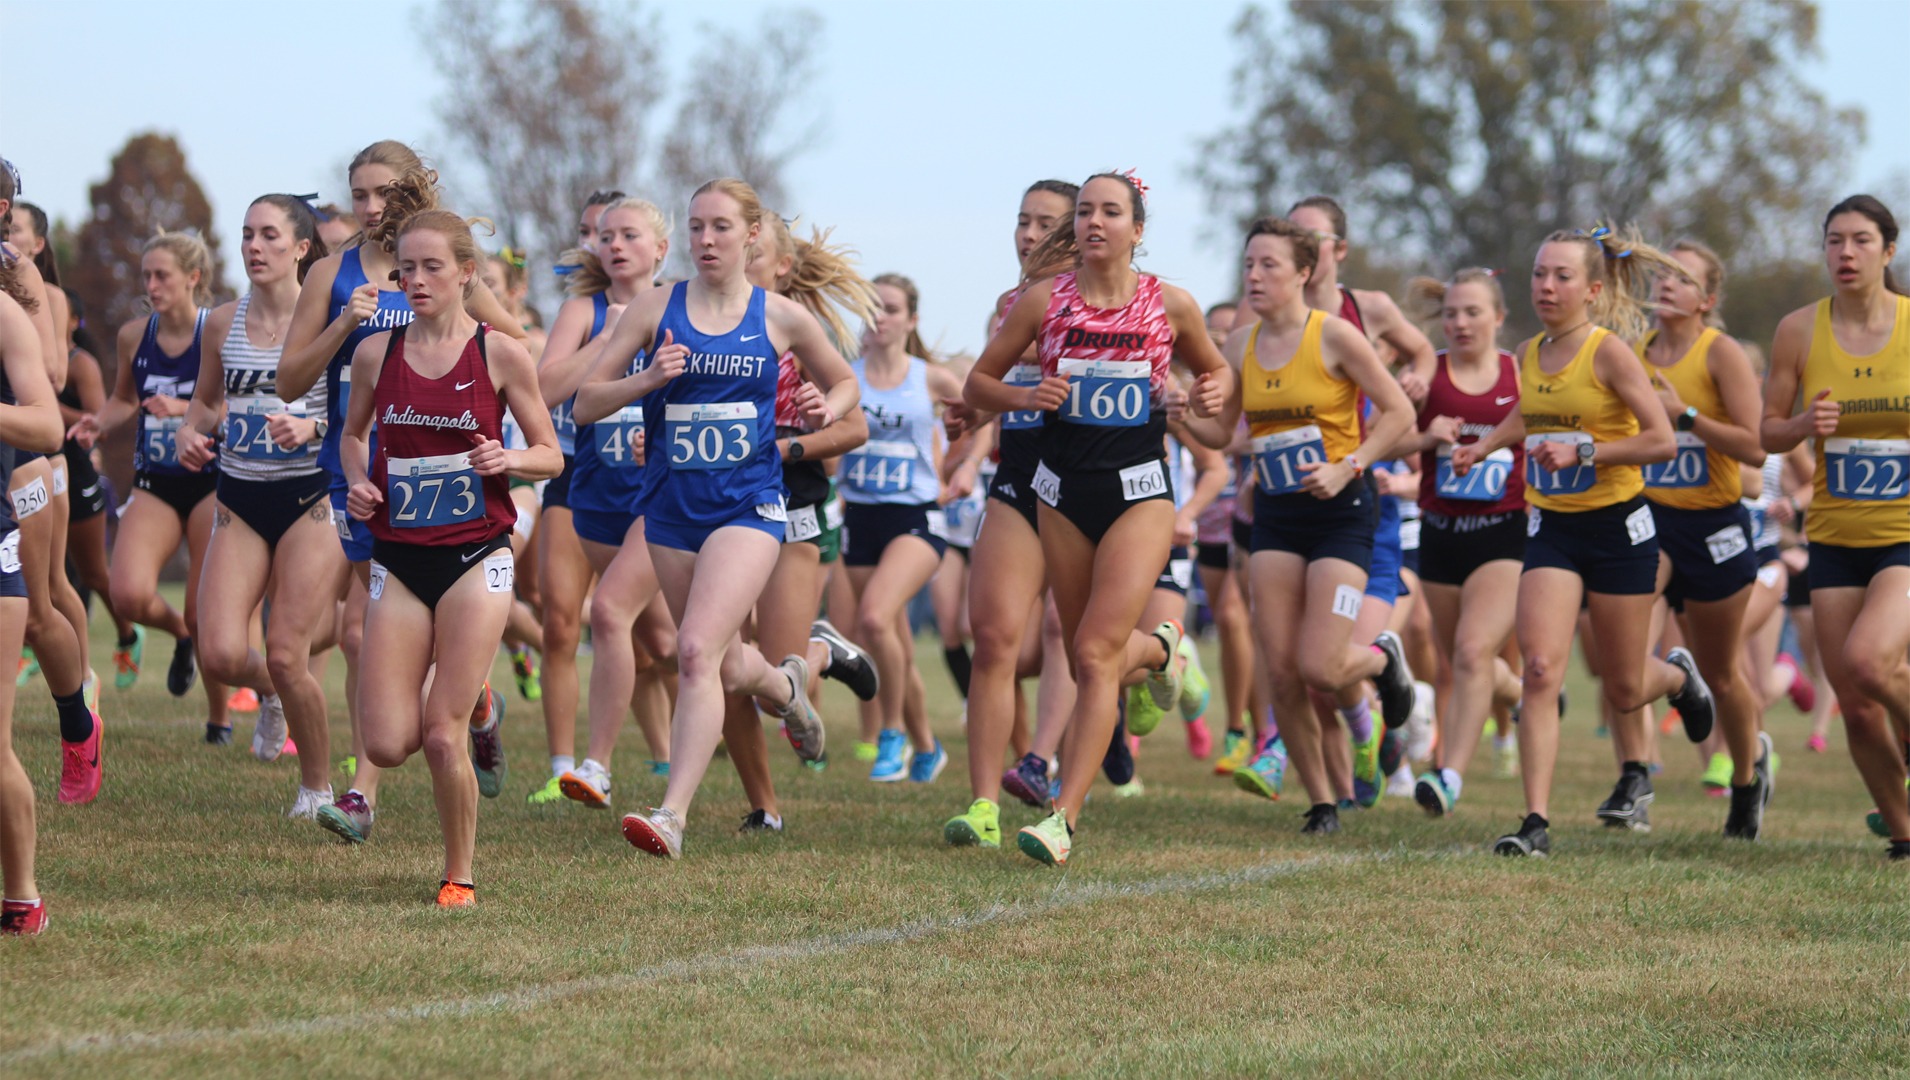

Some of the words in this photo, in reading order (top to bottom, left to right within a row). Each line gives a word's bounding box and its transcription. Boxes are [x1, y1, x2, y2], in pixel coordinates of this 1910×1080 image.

[1064, 327, 1148, 350] DRURY
[1068, 380, 1143, 420] 160
[383, 404, 479, 431] Indianapolis
[671, 423, 751, 463] 503
[848, 457, 910, 491] 444
[1128, 471, 1162, 496] 160
[1440, 462, 1507, 495] 270
[1834, 458, 1903, 495] 122
[17, 486, 46, 515] 250
[393, 475, 476, 521] 273
[791, 514, 817, 538] 158
